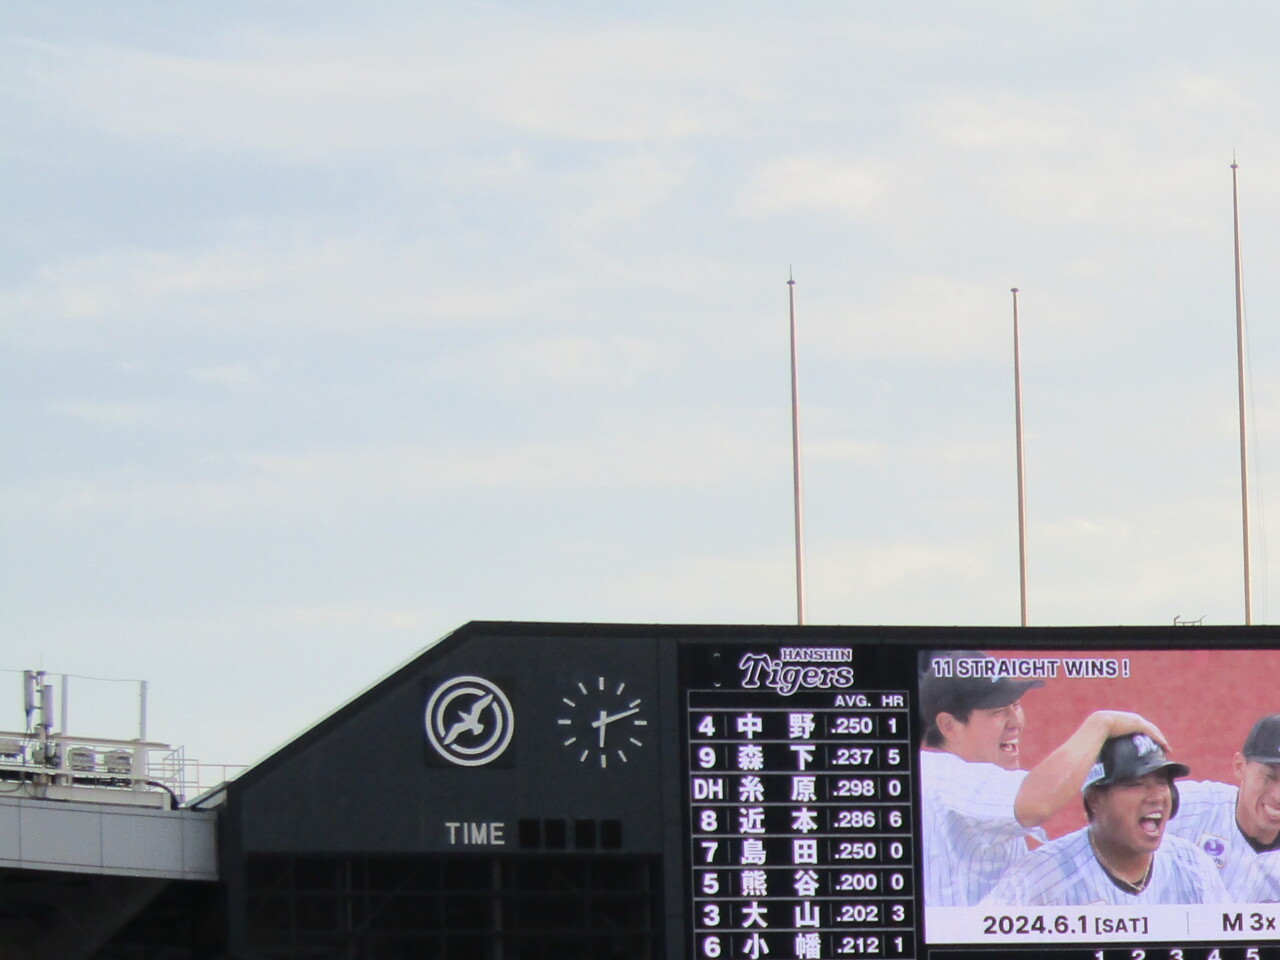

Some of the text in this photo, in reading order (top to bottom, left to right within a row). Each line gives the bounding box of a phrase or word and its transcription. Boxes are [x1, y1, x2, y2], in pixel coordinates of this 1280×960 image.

[781, 648, 852, 662] HANSHIN
[739, 654, 853, 695] Tigers
[933, 658, 953, 678] 11
[957, 659, 1060, 678] STRAIGHT
[1065, 659, 1118, 678] WINS
[834, 694, 904, 708] AVG. HR
[831, 717, 873, 734] .250
[832, 748, 874, 765] .237
[693, 778, 724, 800] DH
[833, 779, 875, 797] .298
[833, 810, 876, 828] .286
[444, 822, 505, 845] TIME
[834, 842, 877, 860] .250
[835, 873, 878, 891] .200
[836, 905, 879, 922] .202
[983, 915, 1149, 935] 2024.6.1 [SAT]
[837, 937, 880, 954] .212
